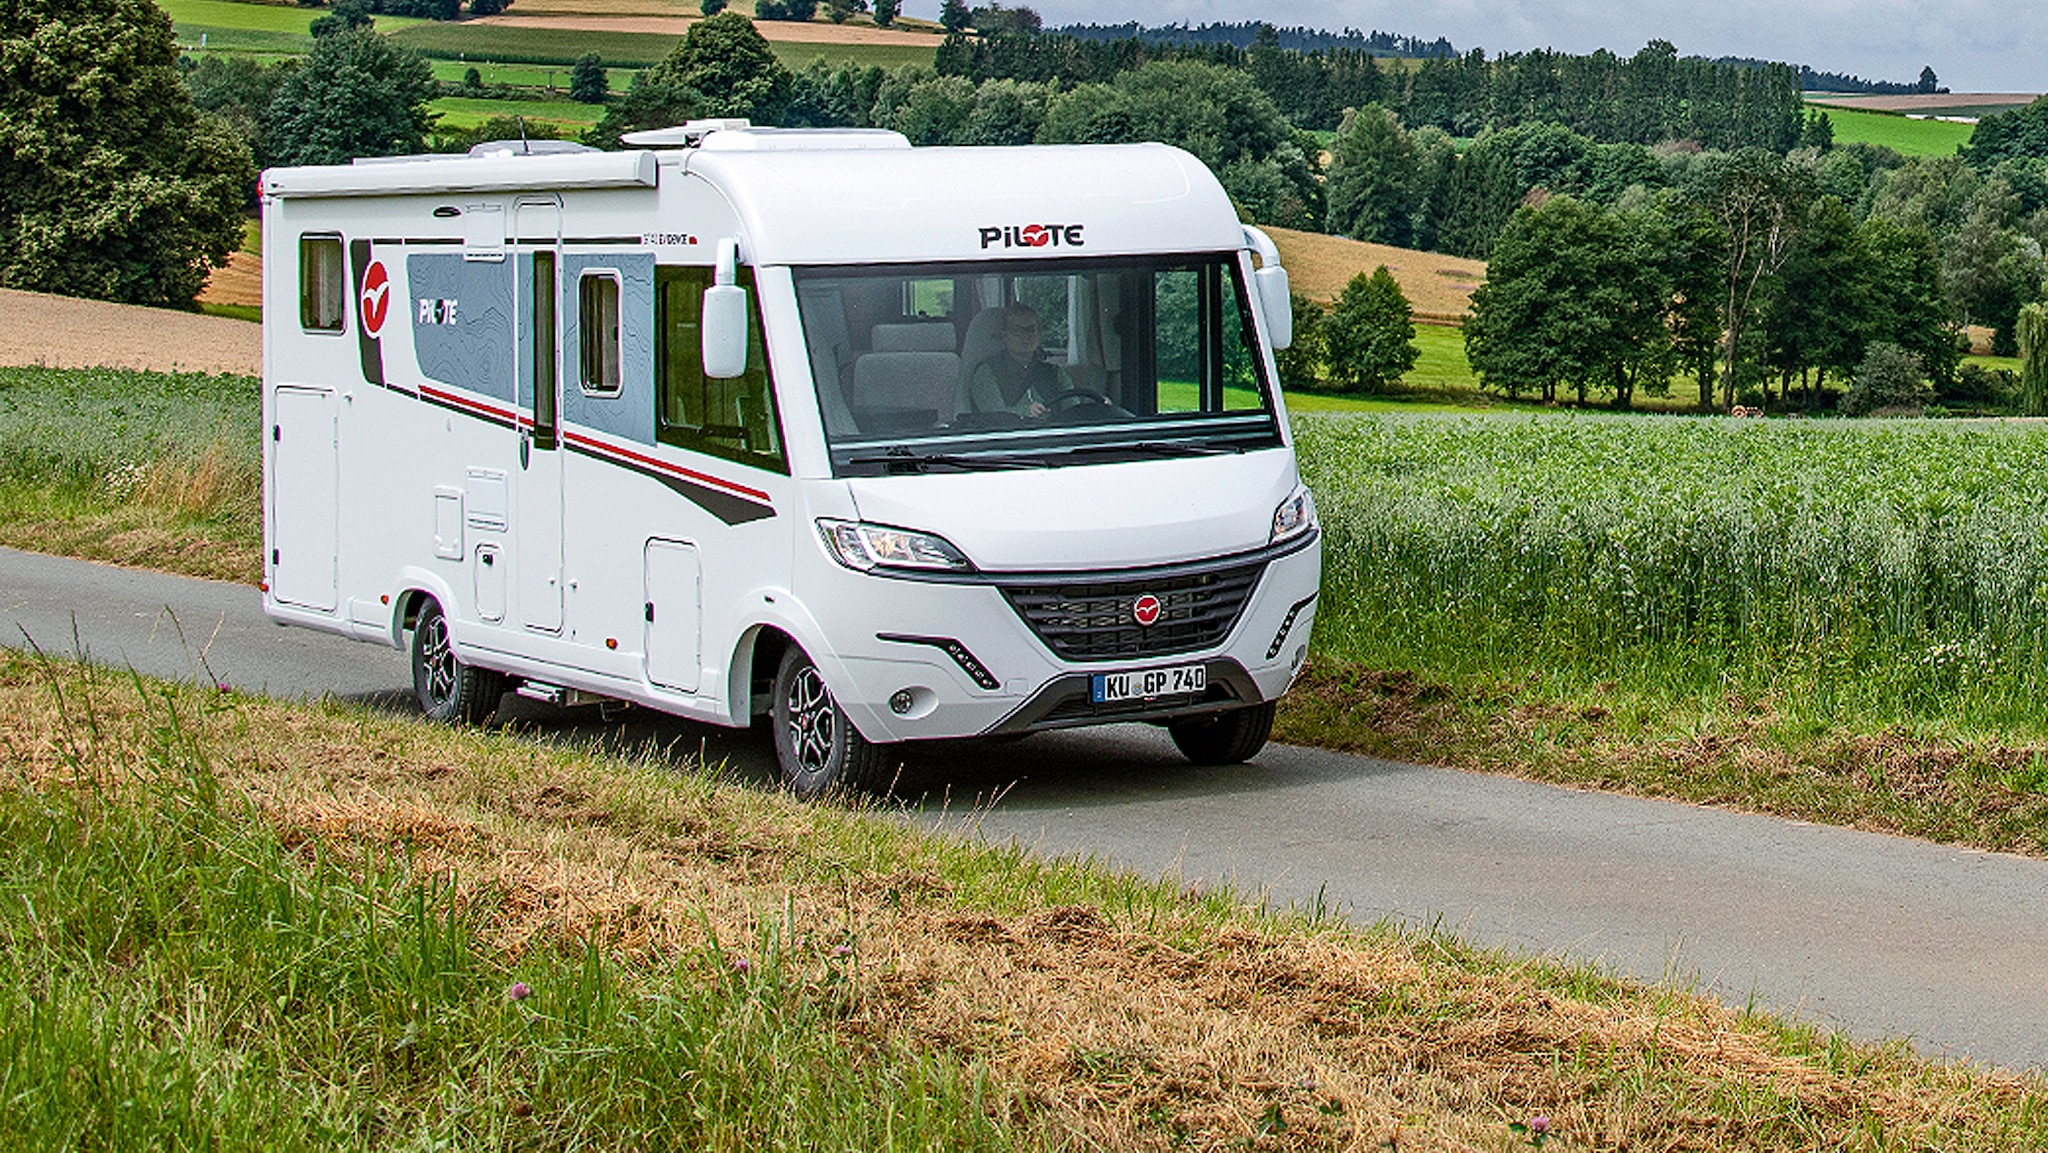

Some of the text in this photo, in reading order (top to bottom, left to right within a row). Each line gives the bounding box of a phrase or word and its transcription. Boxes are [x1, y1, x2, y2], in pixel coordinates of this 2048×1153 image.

[1106, 667, 1205, 698] KU GP 740
